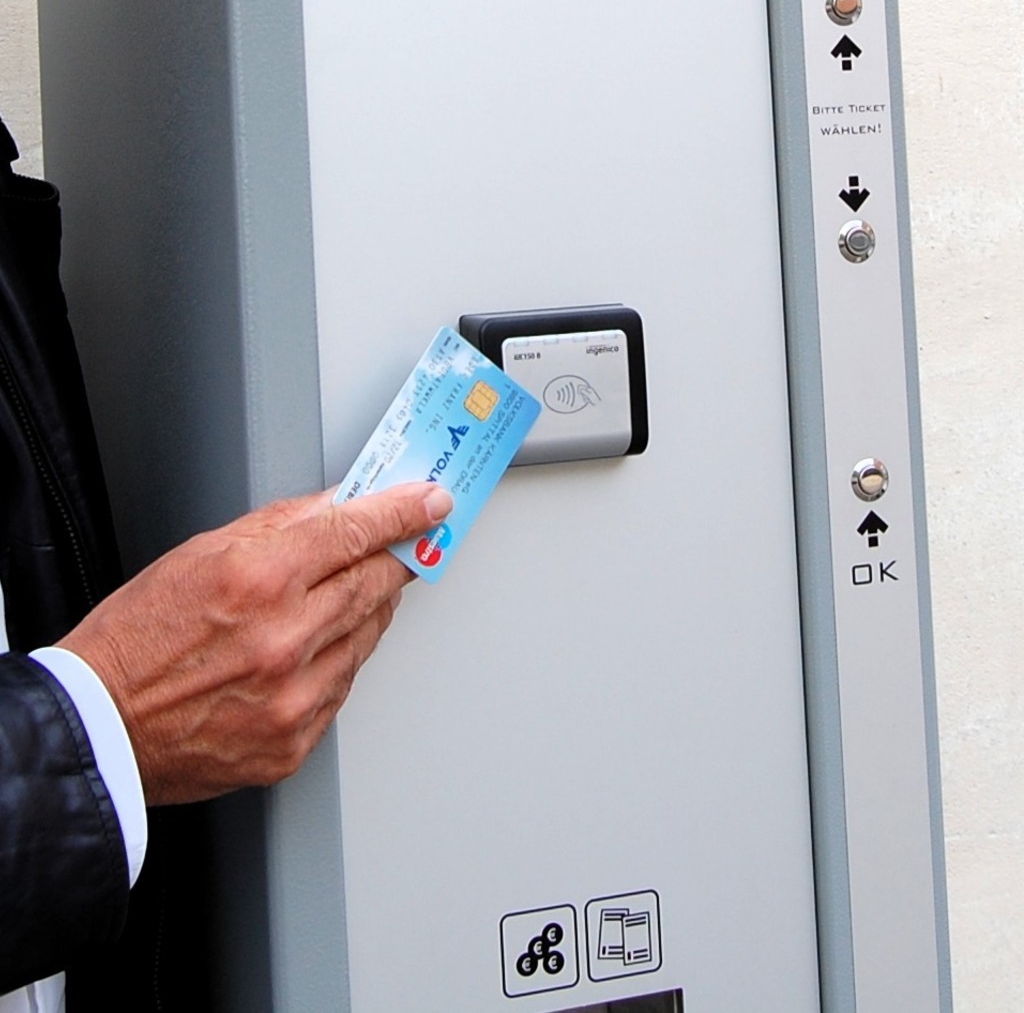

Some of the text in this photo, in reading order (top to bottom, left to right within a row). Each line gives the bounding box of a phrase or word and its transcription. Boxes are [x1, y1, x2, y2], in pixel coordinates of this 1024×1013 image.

[481, 409, 505, 442] SPITTAL
[493, 394, 525, 442] VOLKSBANK
[418, 524, 447, 563] Maestro
[852, 560, 899, 585] OK
